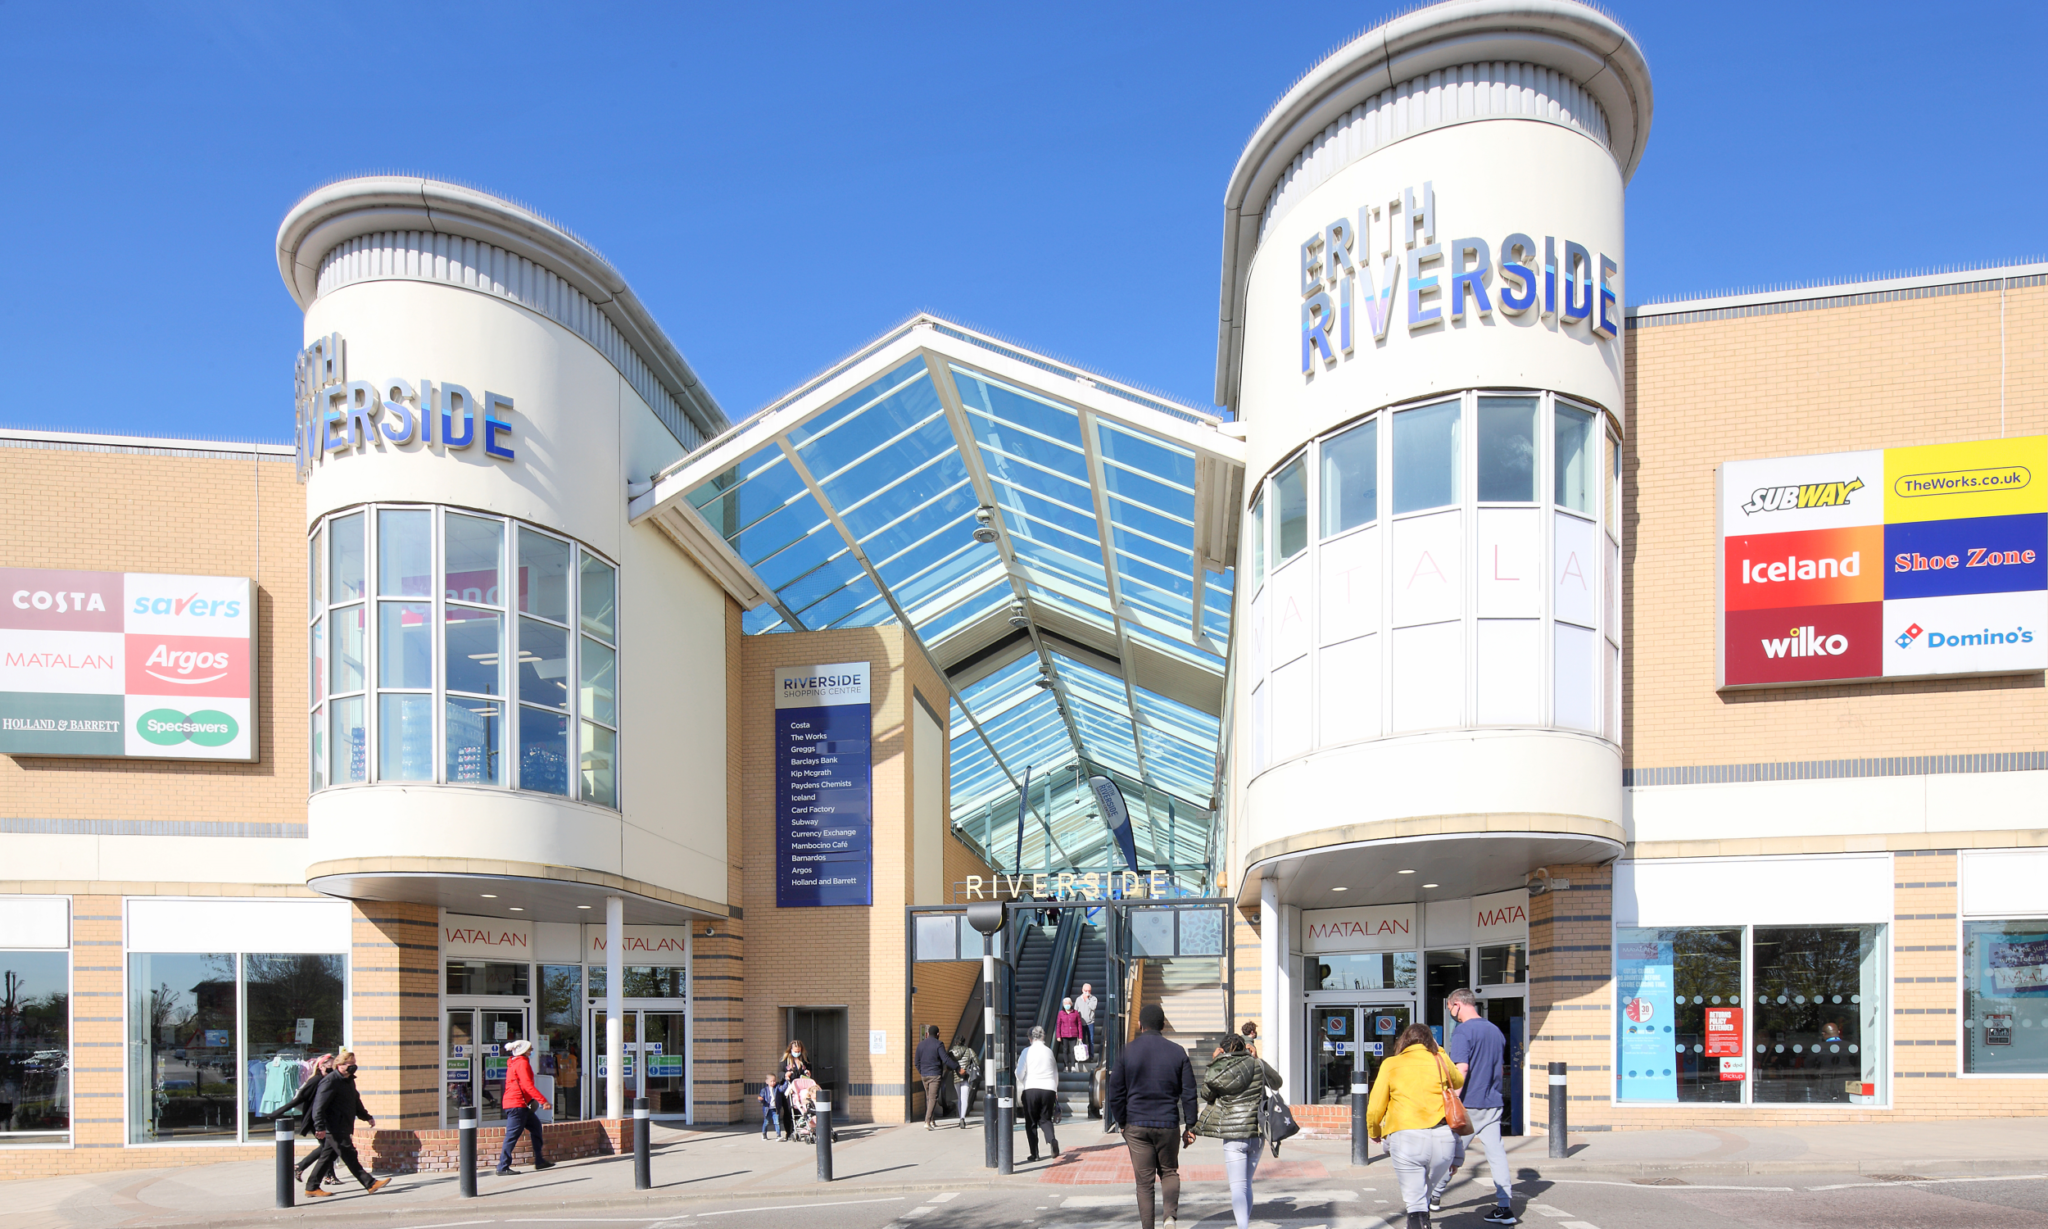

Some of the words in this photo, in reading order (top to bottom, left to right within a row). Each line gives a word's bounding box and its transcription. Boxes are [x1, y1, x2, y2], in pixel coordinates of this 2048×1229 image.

[1301, 181, 1434, 299] ERITH
[1301, 232, 1617, 376] RIVERSIDE
[1905, 472, 2021, 492] TheWorks.co.uk
[1742, 478, 1862, 514] SUBWAY
[1742, 551, 1860, 584] Iceland
[1895, 552, 1959, 573] Shoe
[1966, 548, 2036, 568] Zone
[12, 590, 106, 614] COSTA
[133, 592, 241, 618] savers
[1761, 626, 1849, 659] wilko
[1928, 626, 2034, 648] Domino's
[5, 652, 114, 670] MATALAN
[145, 644, 230, 675] Argos
[784, 674, 861, 690] RIVERSIDE
[784, 689, 826, 698] SHOPPING
[828, 686, 861, 695] CENTRE
[2, 718, 55, 731] HOLLAND
[57, 719, 68, 732] &
[70, 720, 120, 733] BARRETT
[147, 719, 229, 735] Specsavers
[791, 746, 816, 754] Greggs
[791, 758, 819, 766] Barclays
[791, 770, 802, 778] Kip
[804, 769, 832, 777] Mcgrath
[791, 782, 820, 790] Paydens
[821, 780, 852, 788] Chemists
[1099, 784, 1119, 817] RIVERSIDE
[809, 806, 835, 814] Factory
[791, 818, 819, 826] Subway
[791, 830, 822, 838] Currency
[823, 829, 856, 837] Exchange
[832, 840, 848, 848] Café
[792, 854, 826, 862] Barnardos
[792, 867, 812, 875] Argos
[792, 878, 817, 886] Holland
[833, 877, 857, 885] Barrett
[966, 870, 1166, 900] RIVERSIDE
[1309, 919, 1409, 939] MATALAN
[446, 928, 527, 947] ATALAN
[594, 937, 685, 951] MTALAN
[1641, 1005, 1650, 1013] 30
